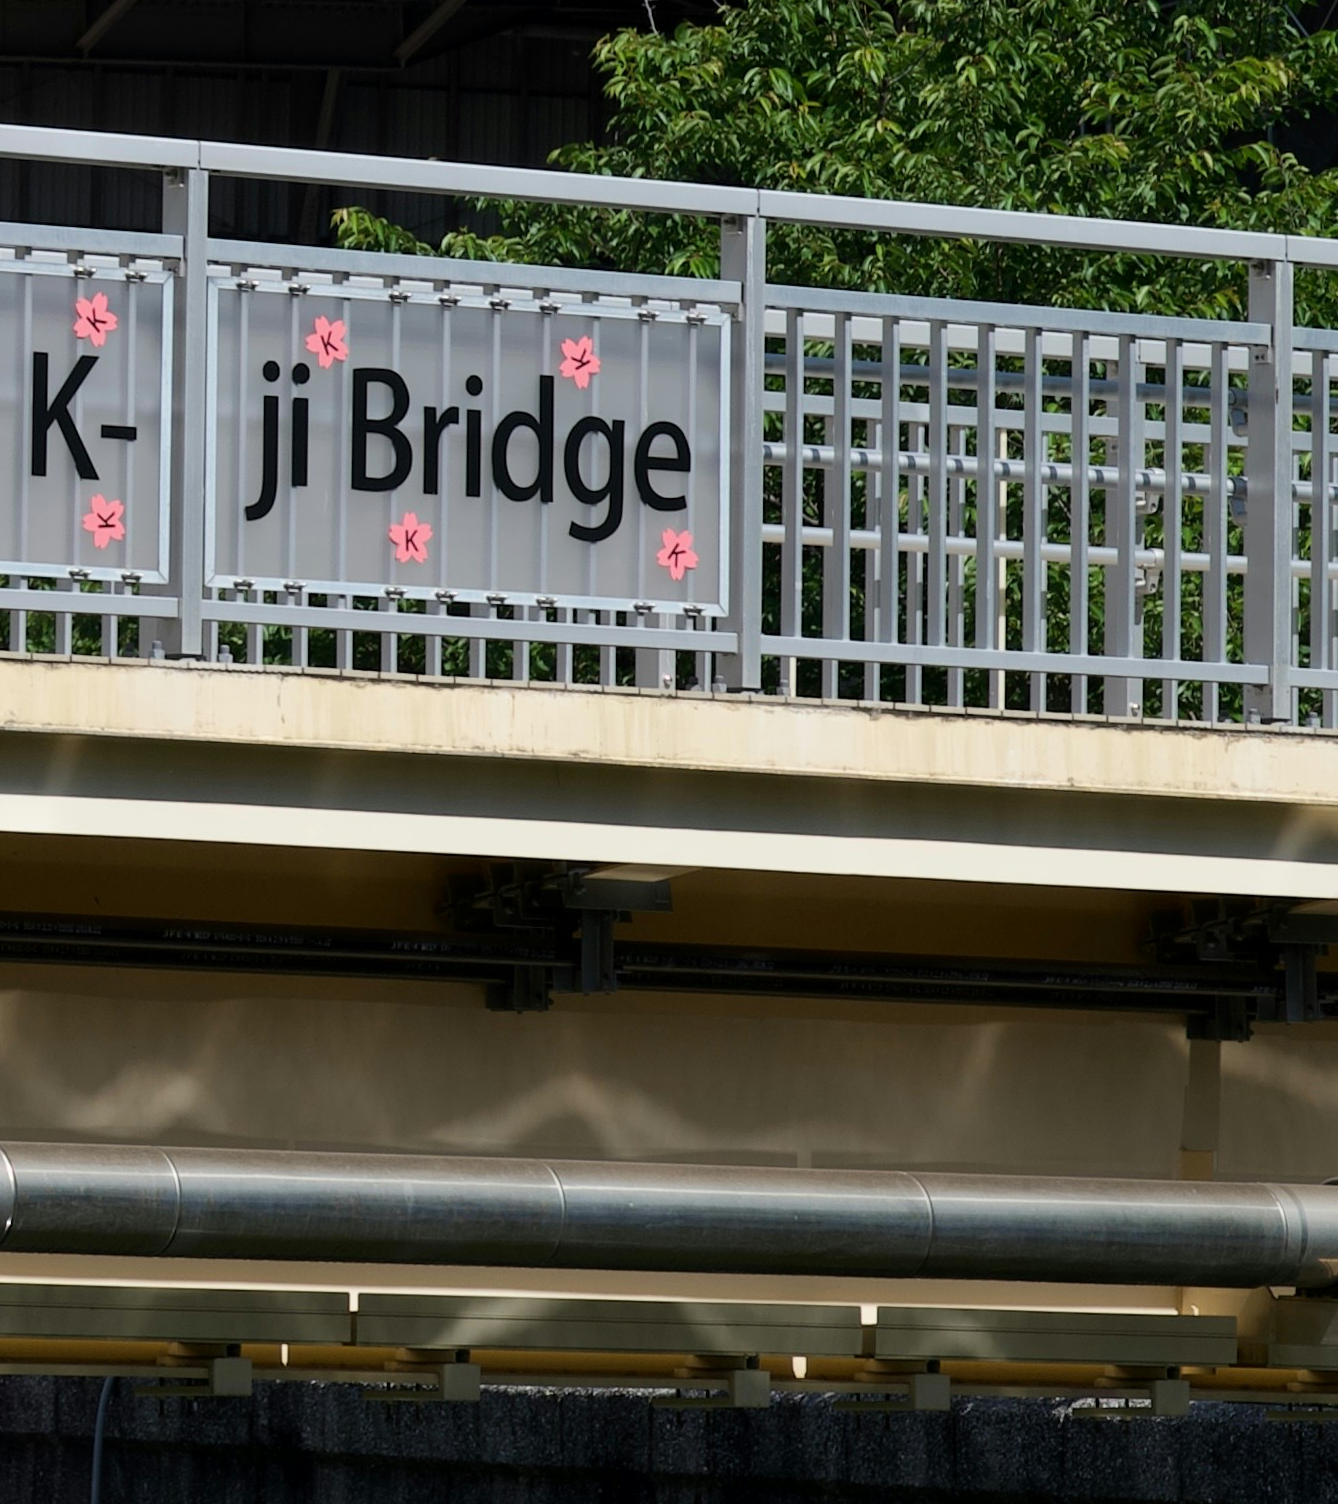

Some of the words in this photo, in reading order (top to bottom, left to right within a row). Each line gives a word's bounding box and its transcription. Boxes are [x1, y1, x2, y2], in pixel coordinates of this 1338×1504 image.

[32, 352, 138, 480] K-
[245, 361, 311, 521] ji
[351, 368, 691, 543] Bridge
